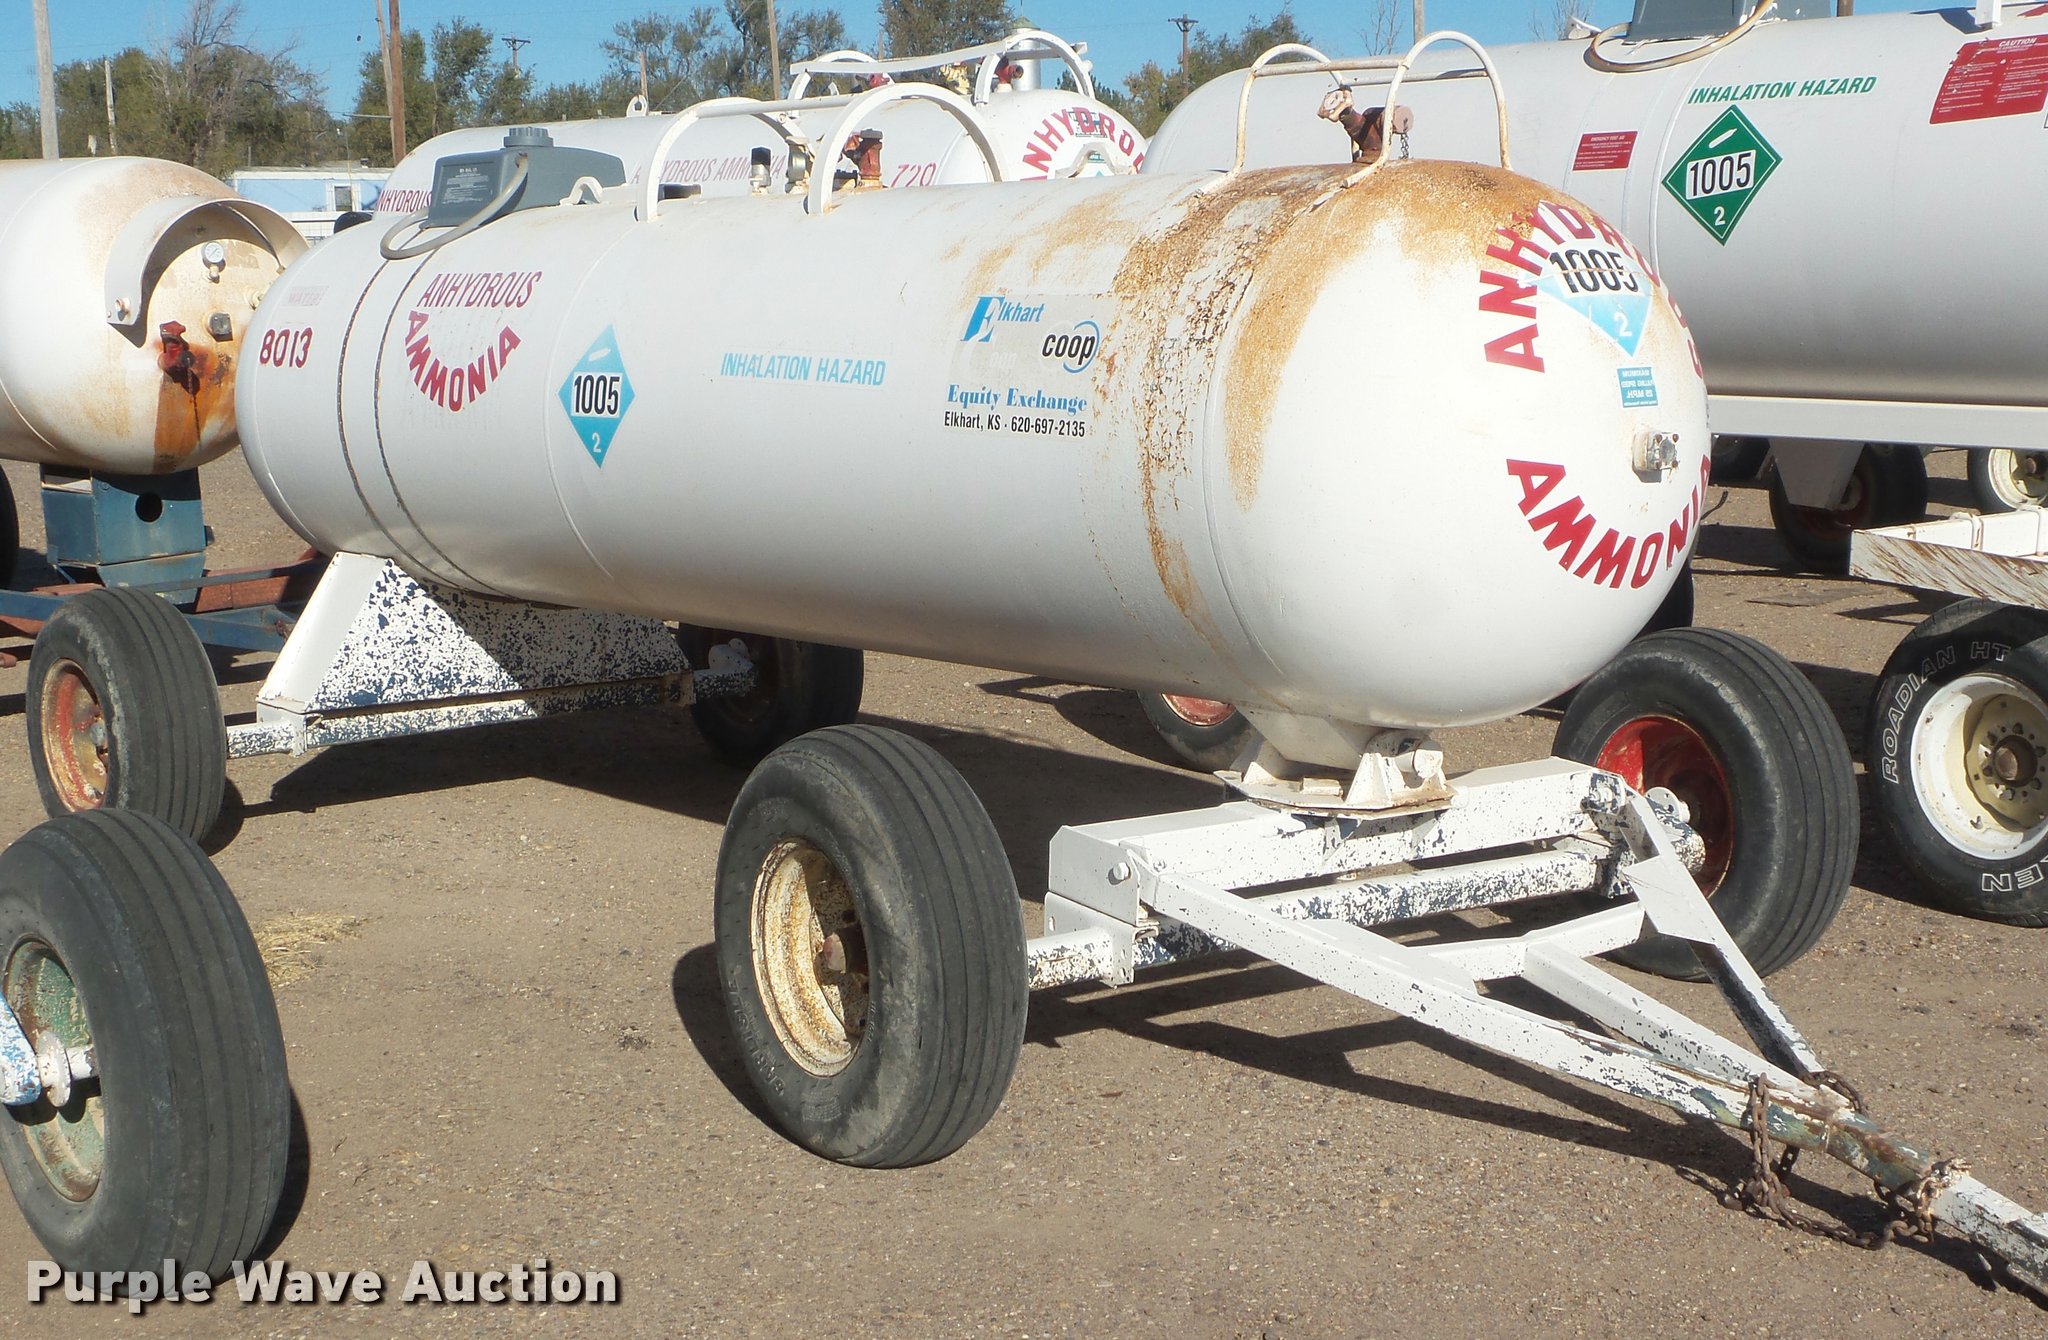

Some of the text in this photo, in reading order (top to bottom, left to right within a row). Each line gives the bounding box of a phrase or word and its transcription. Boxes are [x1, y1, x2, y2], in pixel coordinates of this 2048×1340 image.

[1999, 38, 2037, 47] CAUTION
[1688, 76, 1877, 104] INHALATION HAZARD
[1690, 152, 1752, 197] 1005
[1713, 206, 1726, 226] 2
[1550, 249, 1639, 293] 1005
[416, 271, 542, 308] ANHYDROUS
[960, 295, 1045, 342] Elkhart
[1614, 312, 1632, 337] 2
[260, 328, 313, 368] 8013
[405, 310, 522, 412] AMMONIA
[1042, 333, 1096, 366] coop
[720, 352, 886, 386] INHALATION HAZARD
[574, 375, 620, 415] 1005
[947, 384, 1087, 415] Equity Exchange
[944, 411, 1085, 437] Elkhart, KS 620-697-2135
[592, 432, 601, 453] 2
[1882, 641, 2011, 784] ROADIAN HT
